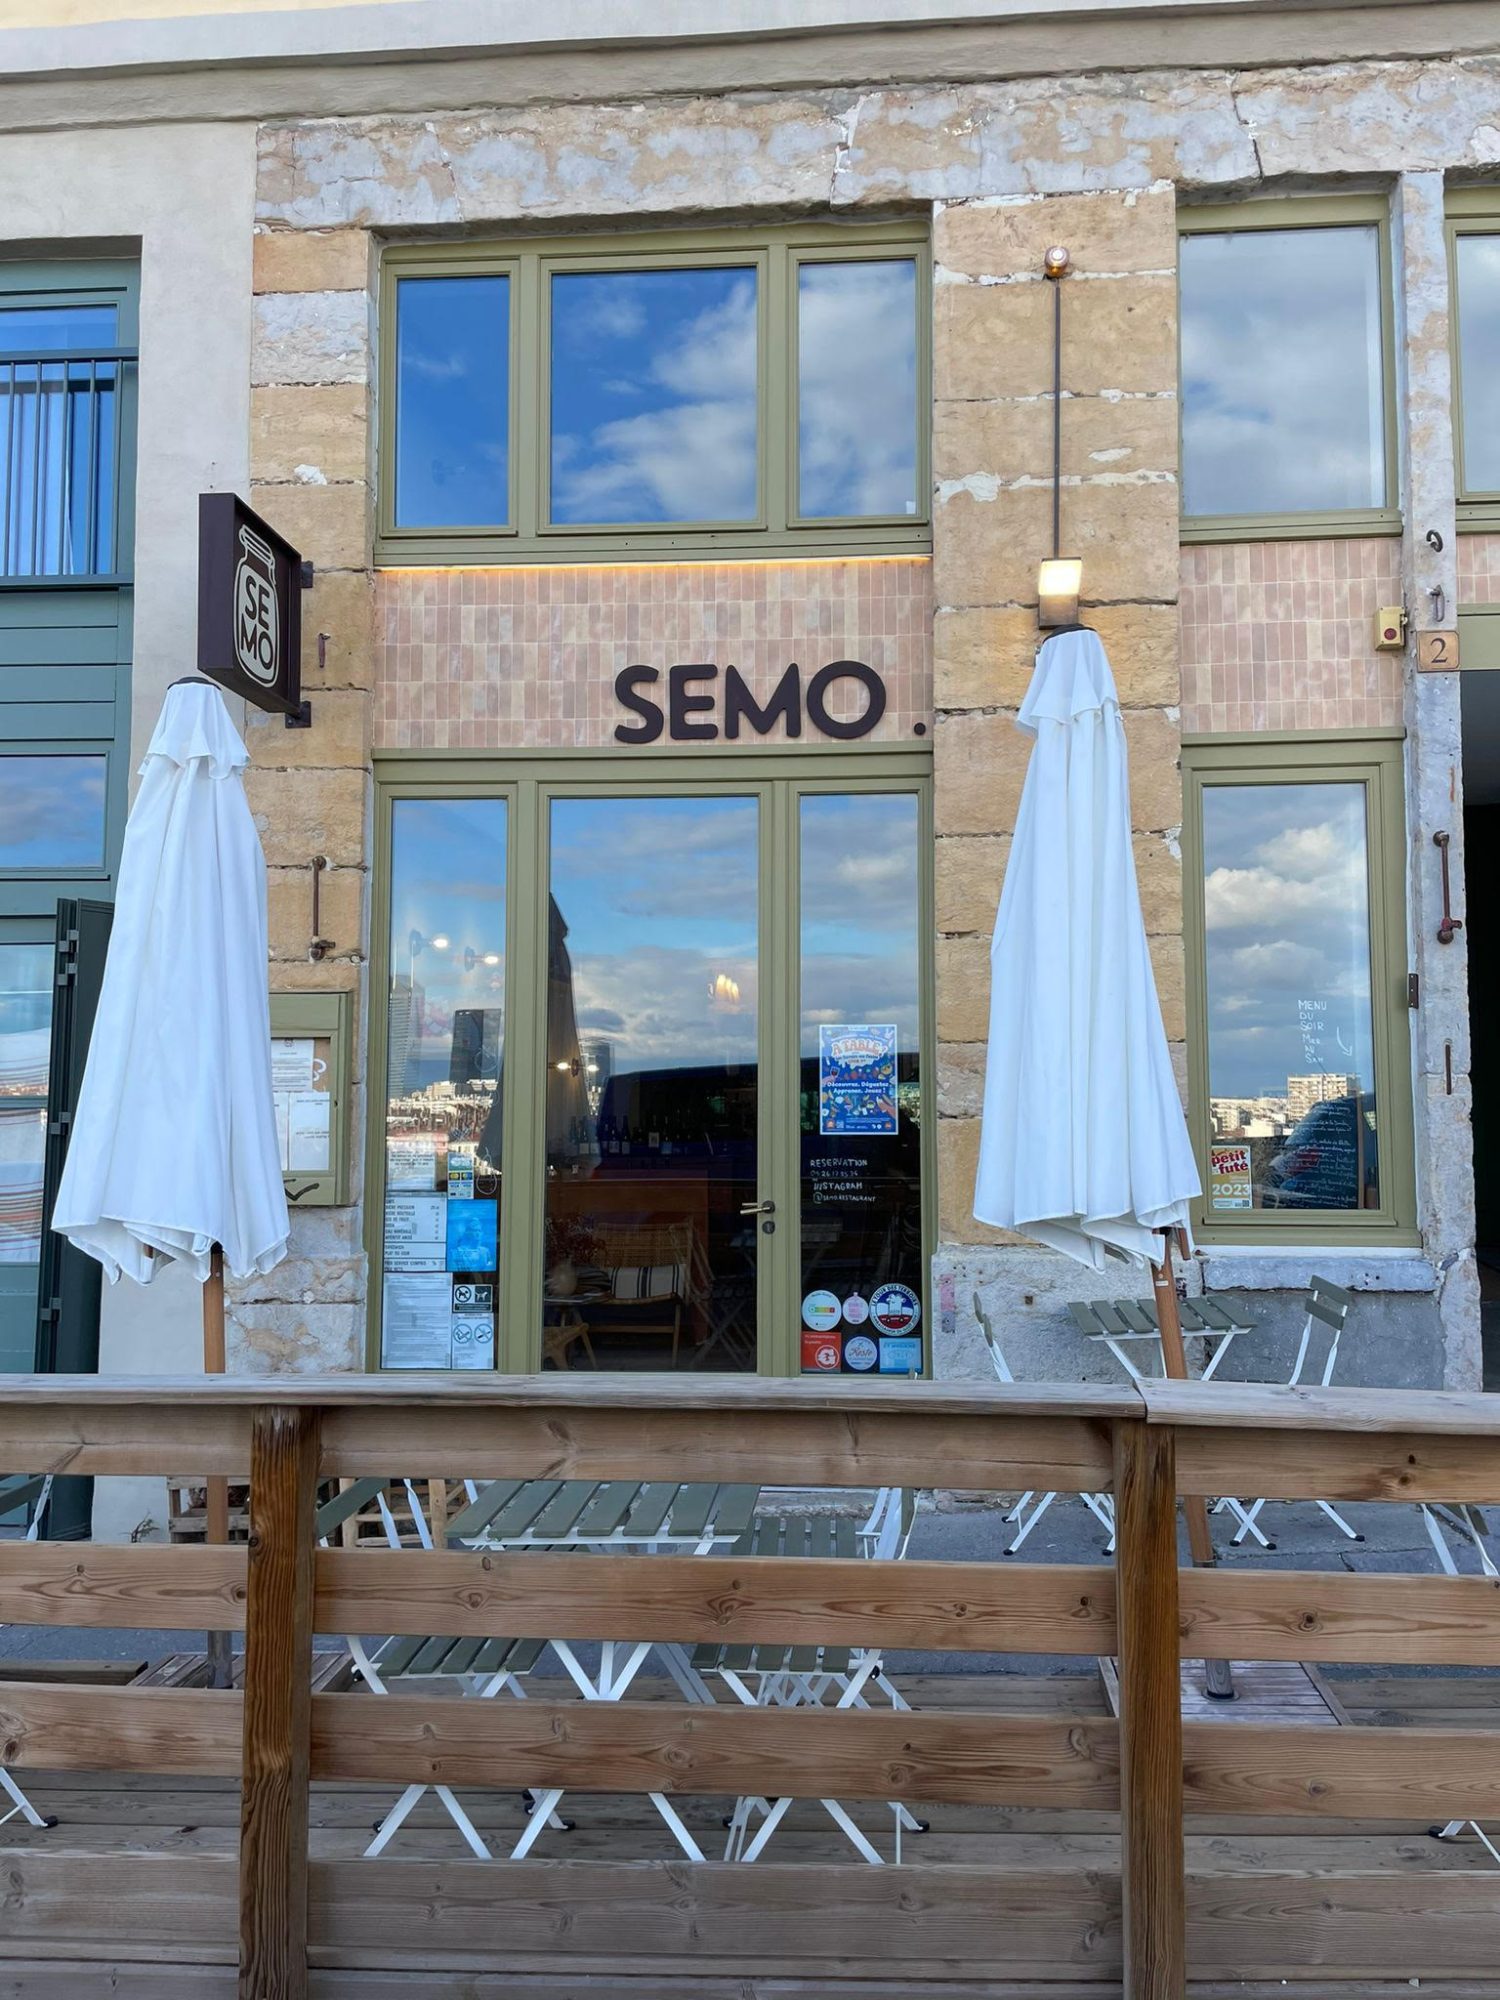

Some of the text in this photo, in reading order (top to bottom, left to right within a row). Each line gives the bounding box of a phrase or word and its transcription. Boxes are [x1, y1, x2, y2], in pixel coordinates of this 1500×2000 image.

[244, 575, 270, 631] SE
[241, 613, 273, 671] MO
[1430, 637, 1448, 663] 2
[1297, 999, 1328, 1011] MENU
[1299, 1011, 1314, 1020] DU
[1300, 1020, 1325, 1031] SOIR
[1211, 1149, 1247, 1167] petit
[1218, 1160, 1249, 1175] futé
[1212, 1183, 1250, 1196] 2023
